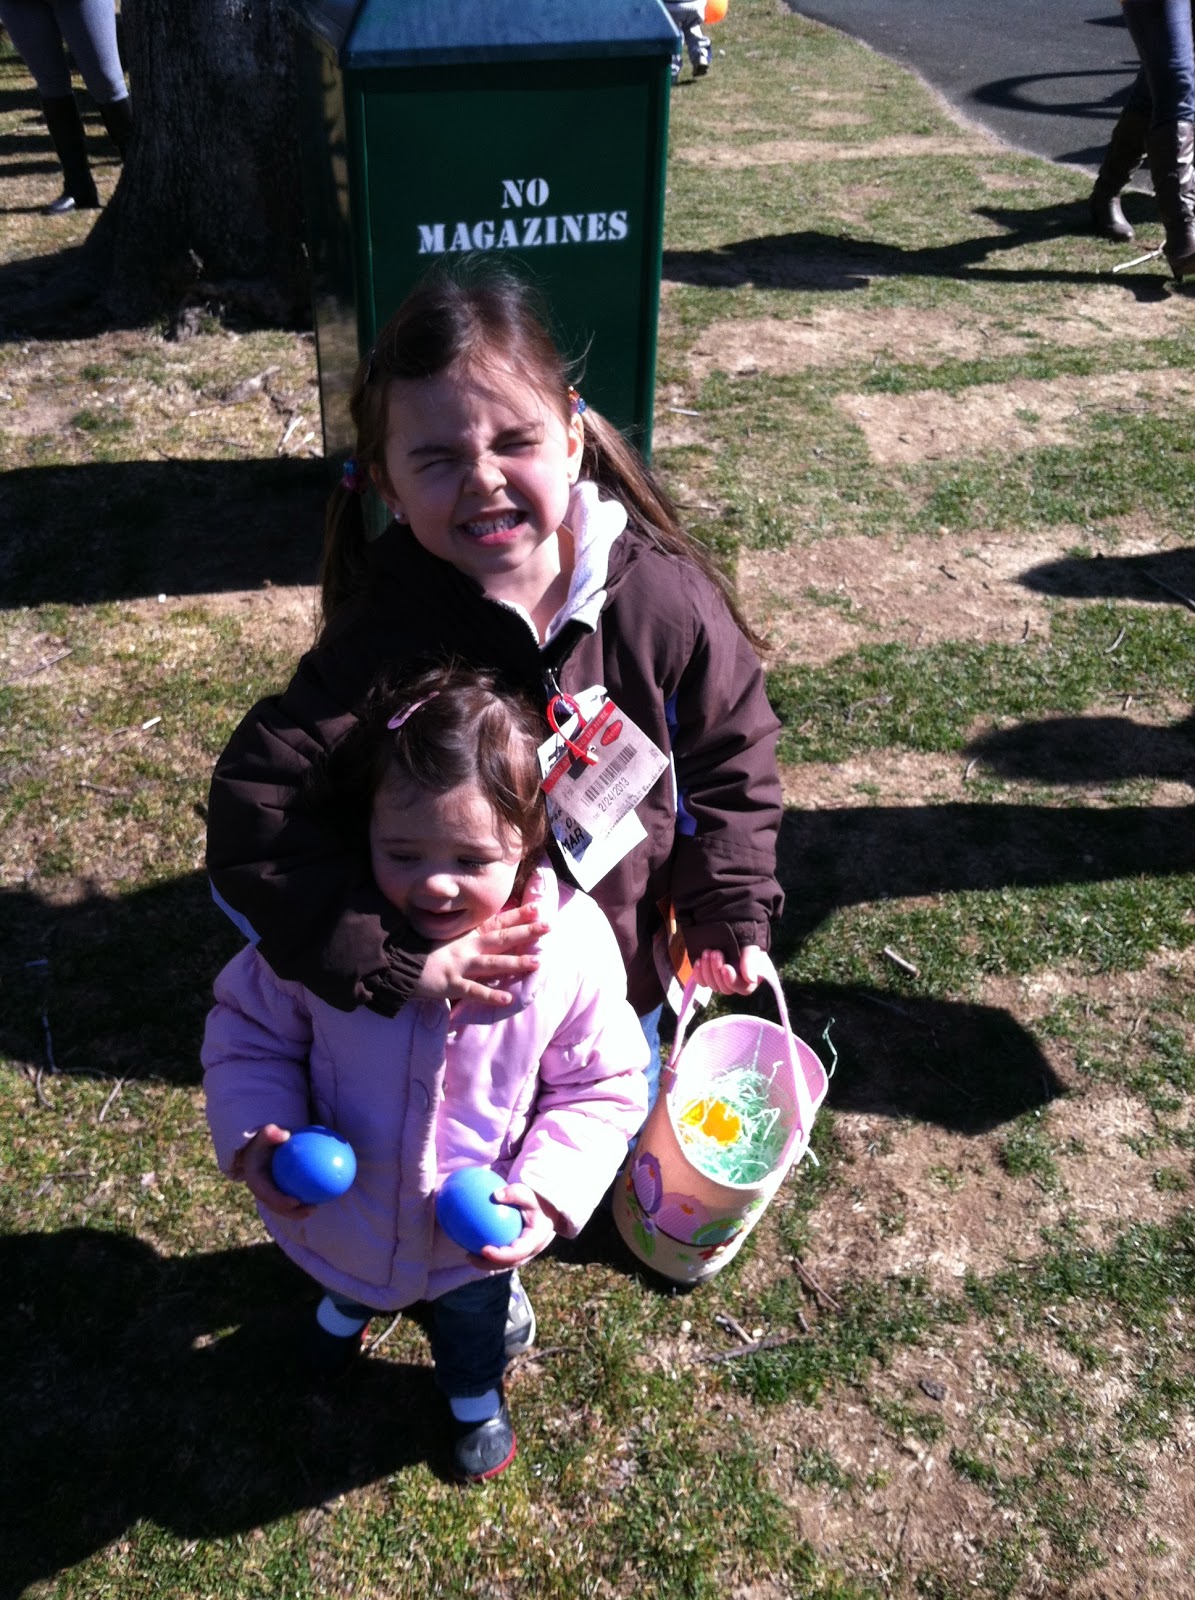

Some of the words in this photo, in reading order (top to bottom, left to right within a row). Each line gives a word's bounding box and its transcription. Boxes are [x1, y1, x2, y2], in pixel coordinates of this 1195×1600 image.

[501, 178, 549, 208] NO
[417, 211, 628, 254] MAGAZINES
[598, 777, 630, 812] 2/24/2013
[561, 827, 584, 854] MAR
